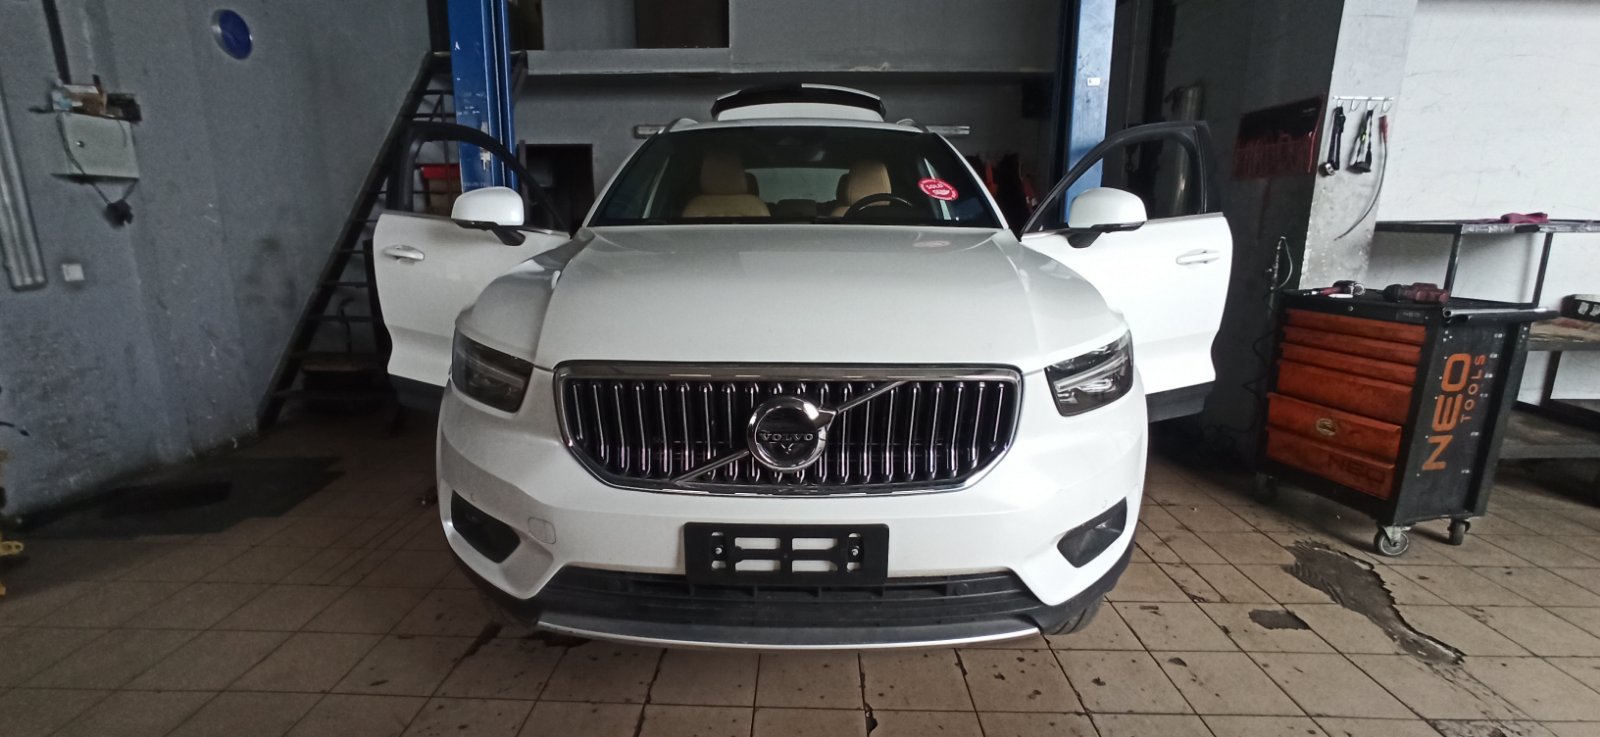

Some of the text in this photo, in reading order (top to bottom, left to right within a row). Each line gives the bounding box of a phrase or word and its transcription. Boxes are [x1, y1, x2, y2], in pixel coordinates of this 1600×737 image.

[1422, 353, 1472, 471] NEO
[1460, 354, 1486, 423] TOOLS
[760, 432, 814, 441] VOLVO
[1328, 454, 1387, 484] NEO
